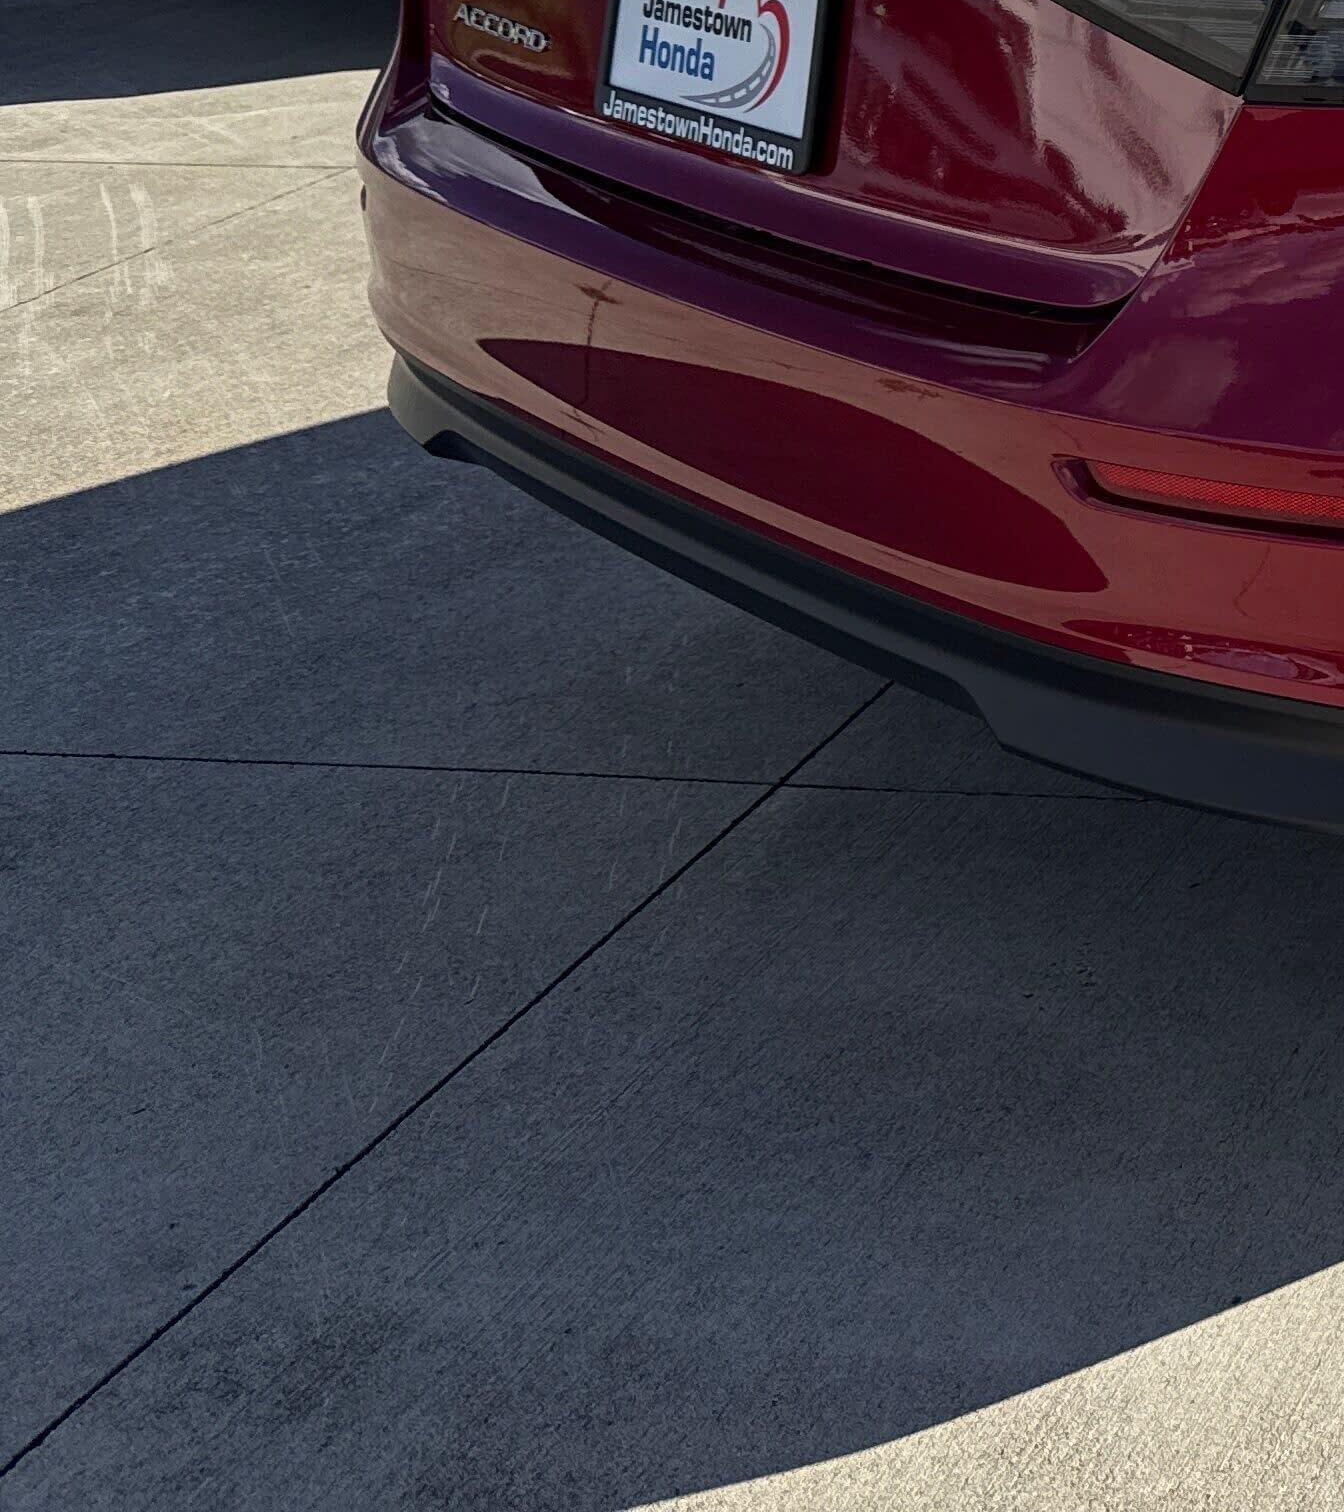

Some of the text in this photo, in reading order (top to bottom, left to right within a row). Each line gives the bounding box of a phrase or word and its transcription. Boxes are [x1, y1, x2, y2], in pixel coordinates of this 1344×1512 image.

[452, 3, 547, 52] ACCORD
[639, 24, 715, 81] Honda
[603, 90, 793, 170] JamestownHonda.com
